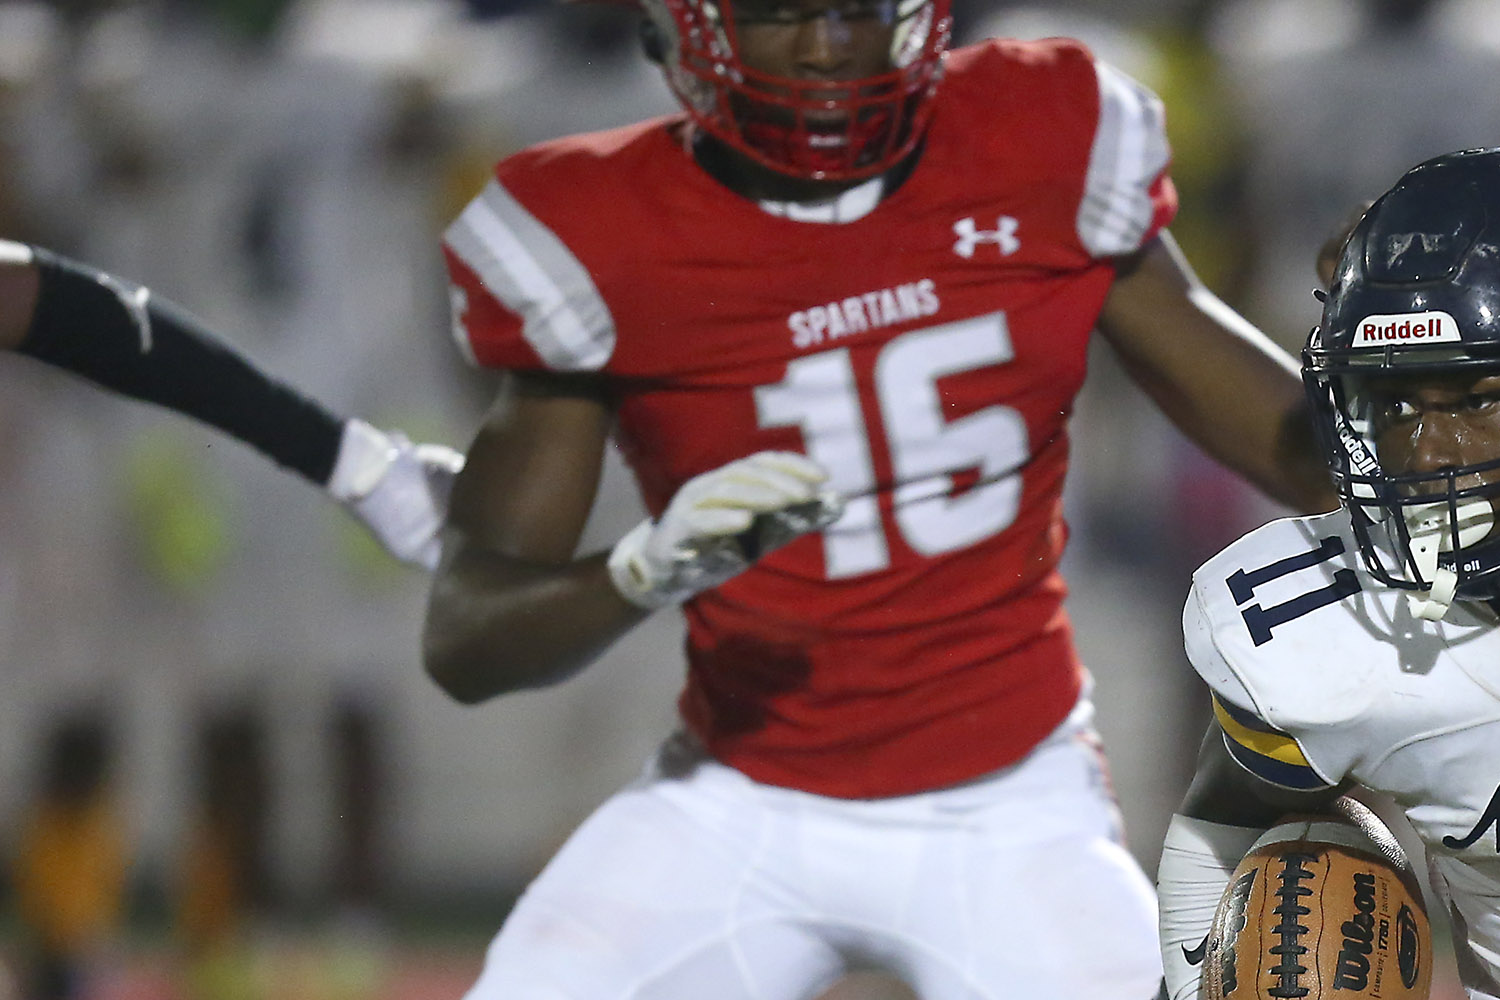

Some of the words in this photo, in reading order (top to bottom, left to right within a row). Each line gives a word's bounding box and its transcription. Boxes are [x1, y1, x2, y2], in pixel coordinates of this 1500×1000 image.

[787, 279, 940, 348] SPARTANS
[1363, 319, 1441, 341] Riddell
[753, 310, 1030, 581] 16
[1225, 536, 1362, 647] 11
[1333, 873, 1375, 991] Wilson
